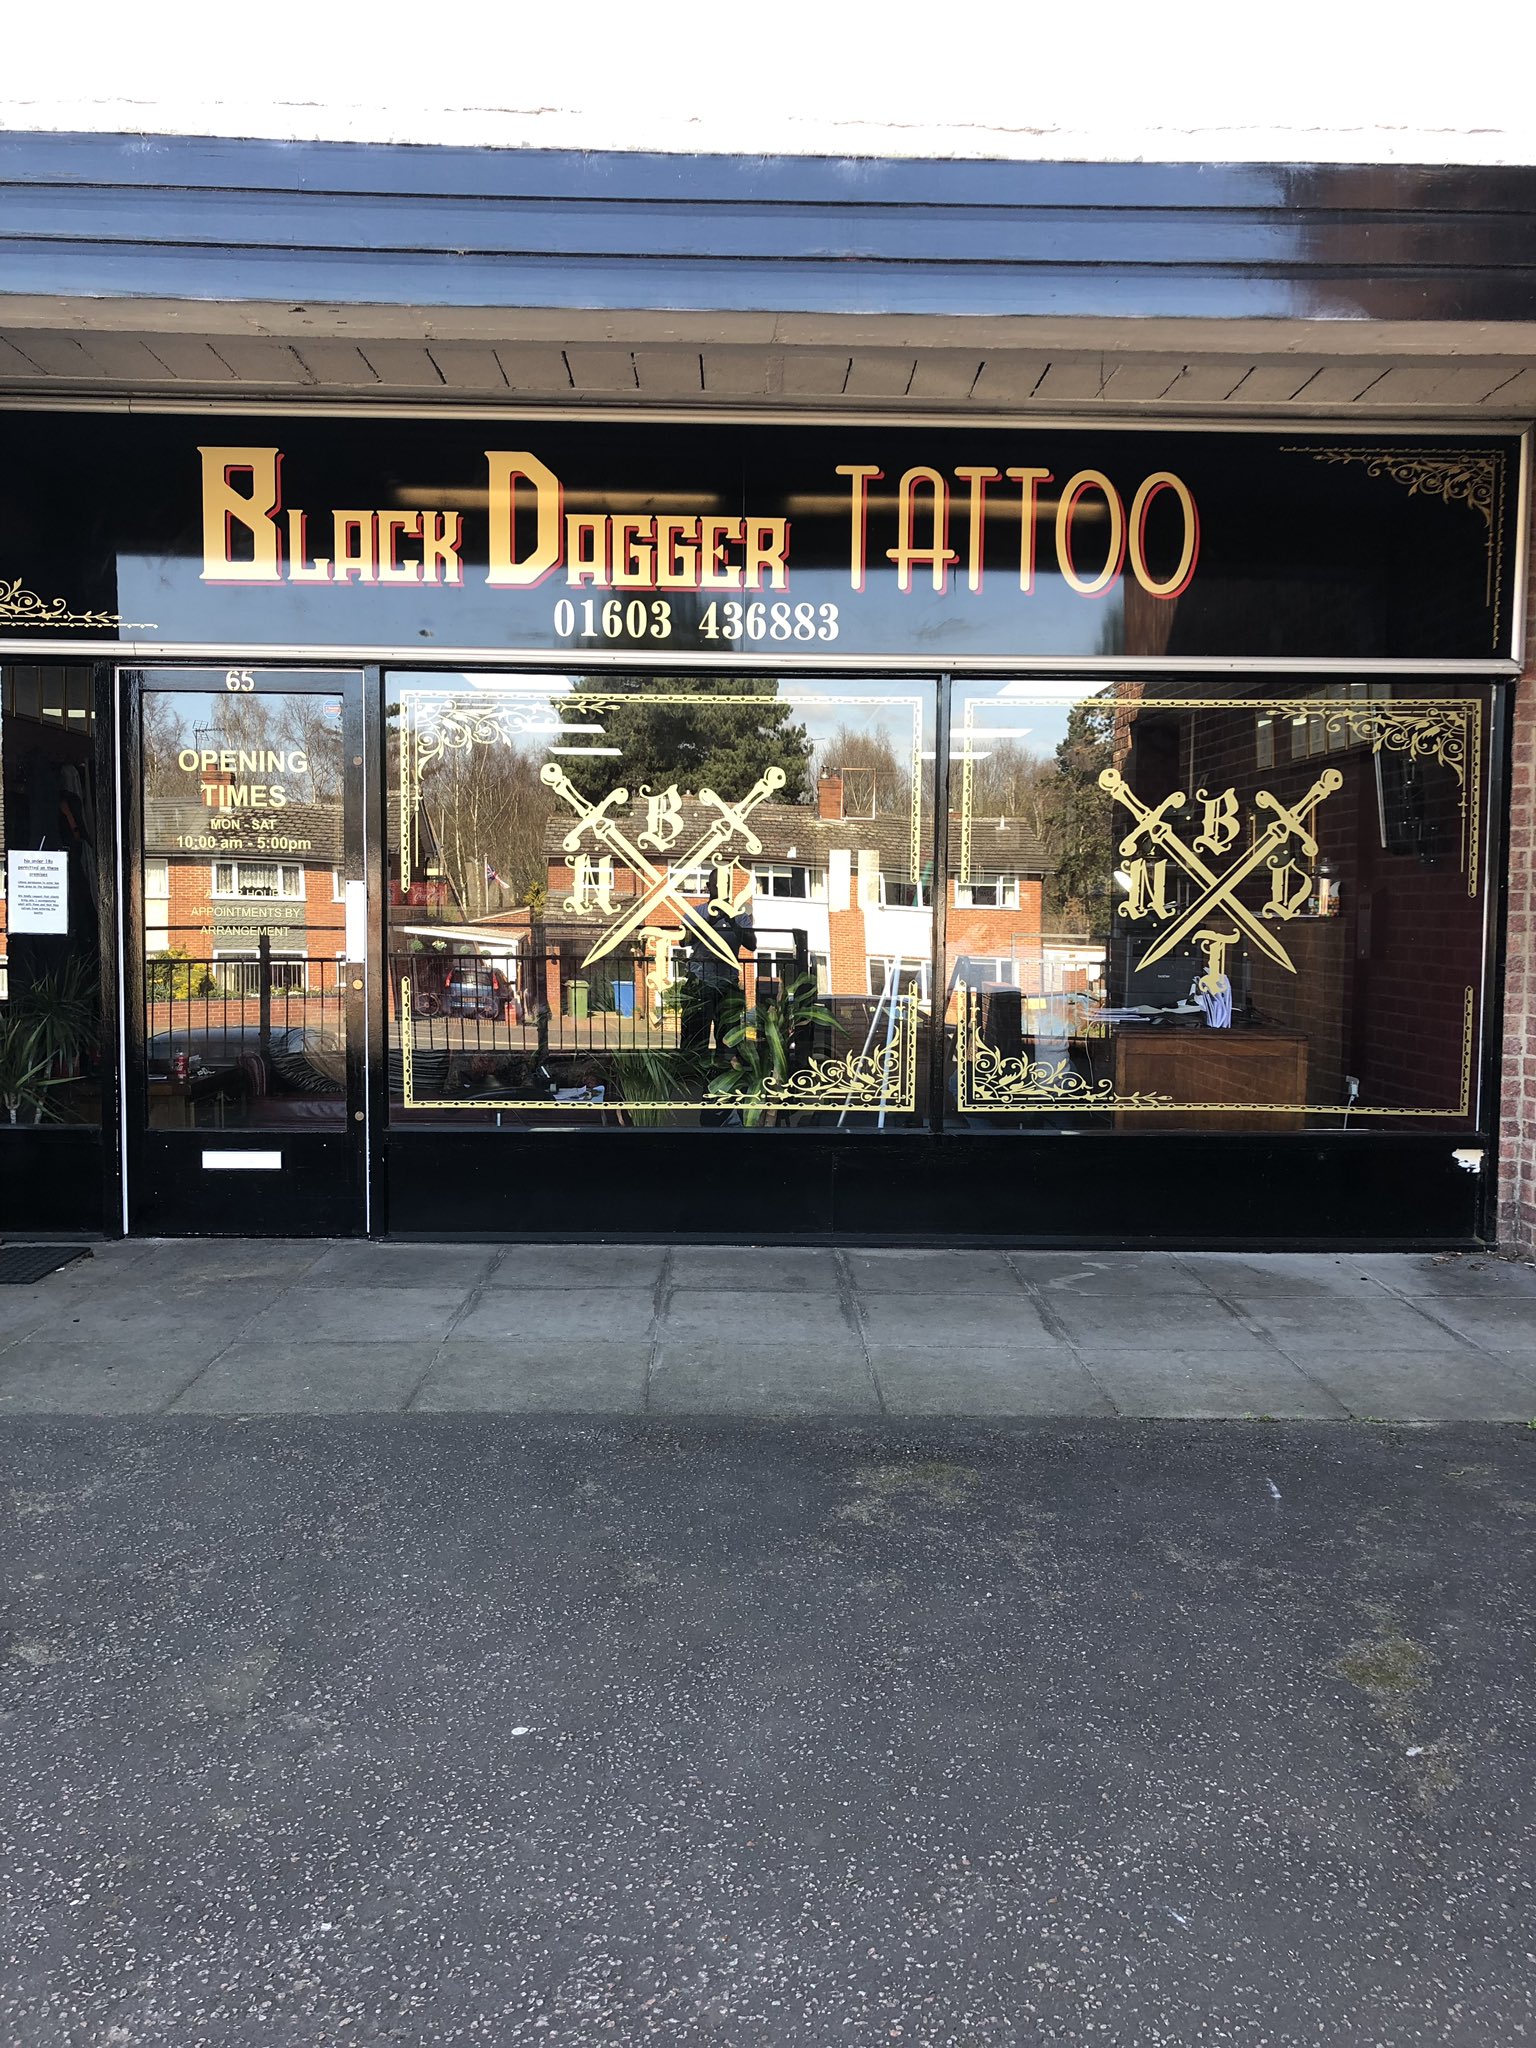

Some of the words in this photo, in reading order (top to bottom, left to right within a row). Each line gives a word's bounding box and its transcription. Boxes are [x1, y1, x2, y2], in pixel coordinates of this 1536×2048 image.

[835, 465, 1199, 599] TATTOO
[553, 599, 672, 638] 01603
[699, 601, 839, 641] 436883
[226, 670, 255, 691] 65
[178, 749, 308, 773] OPENING
[202, 784, 287, 808] TIMES
[211, 819, 240, 830] MON
[252, 819, 276, 830] SAT
[178, 836, 216, 849] 10:00
[221, 839, 243, 849] am
[257, 837, 312, 852] 5:00pm
[191, 906, 282, 917] APPOINTMENTS
[285, 908, 301, 918] BY
[200, 926, 291, 936] ARRANGEMENT
